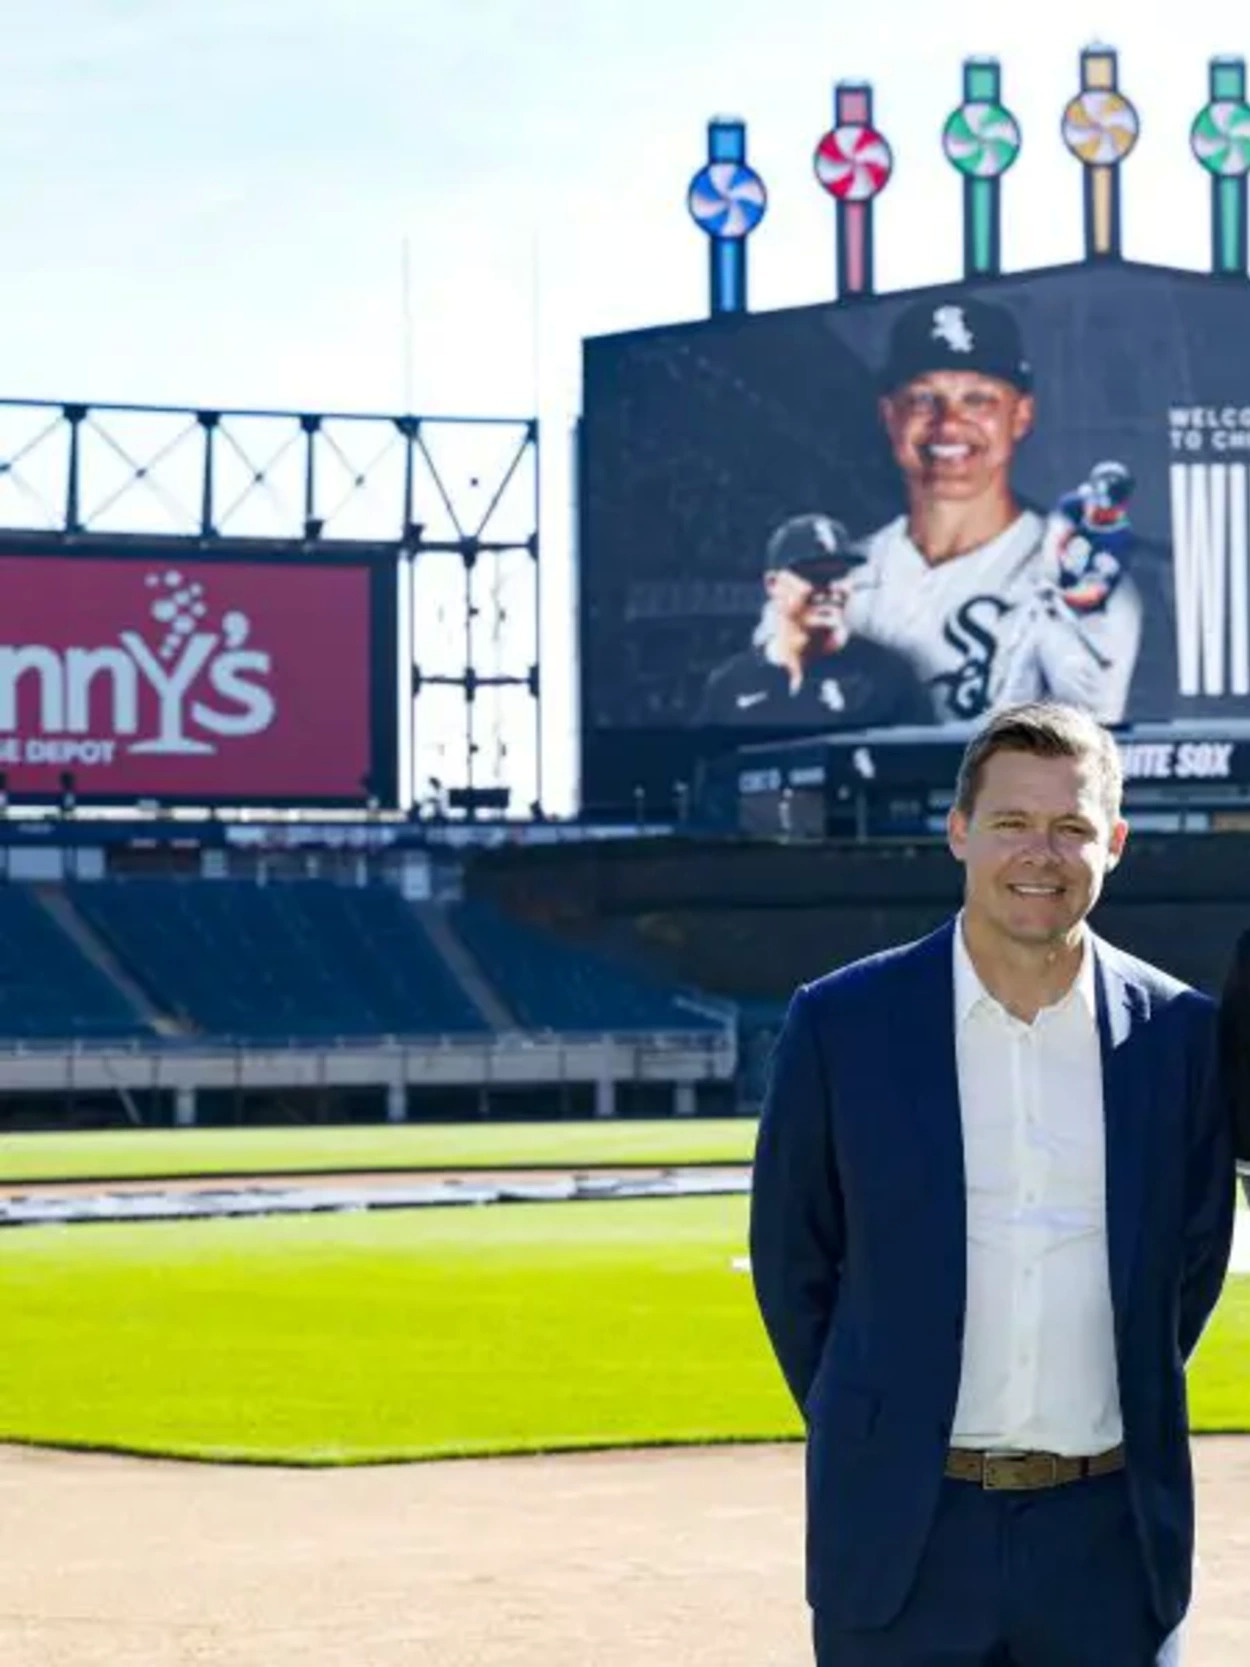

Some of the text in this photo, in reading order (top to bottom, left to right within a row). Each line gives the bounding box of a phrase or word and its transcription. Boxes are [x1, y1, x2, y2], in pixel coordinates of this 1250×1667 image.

[1170, 429, 1203, 450] TO
[25, 738, 116, 765] DEPOT
[1174, 741, 1234, 778] SOX
